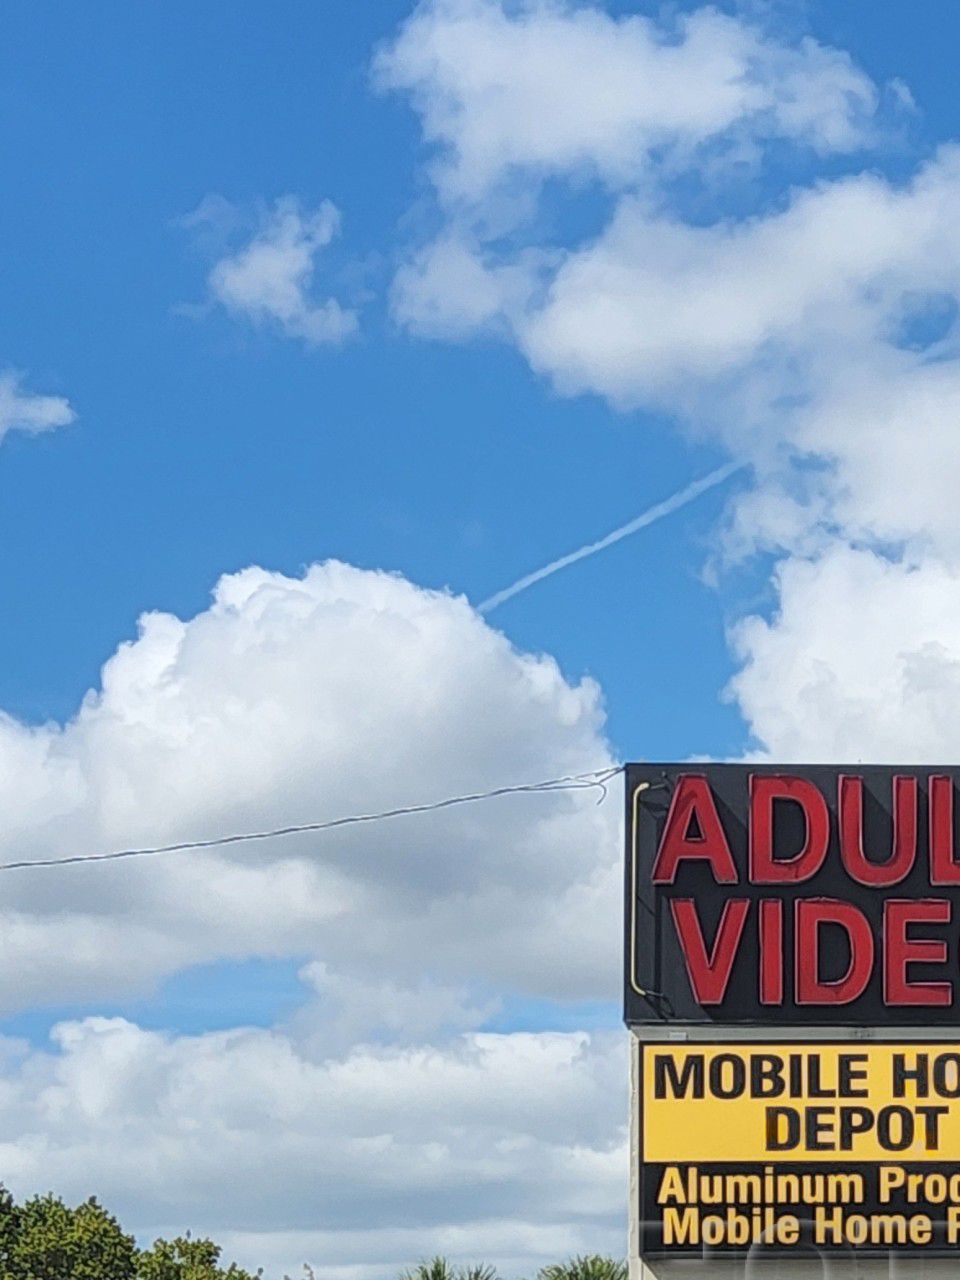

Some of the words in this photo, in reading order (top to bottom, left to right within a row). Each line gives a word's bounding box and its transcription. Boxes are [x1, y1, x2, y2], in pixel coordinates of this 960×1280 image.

[653, 1053, 869, 1100] MOBILE
[765, 1105, 949, 1152] DEPOT
[657, 1166, 864, 1205] Aluminum
[662, 1207, 799, 1245] Mobile
[815, 1207, 932, 1245] Home
